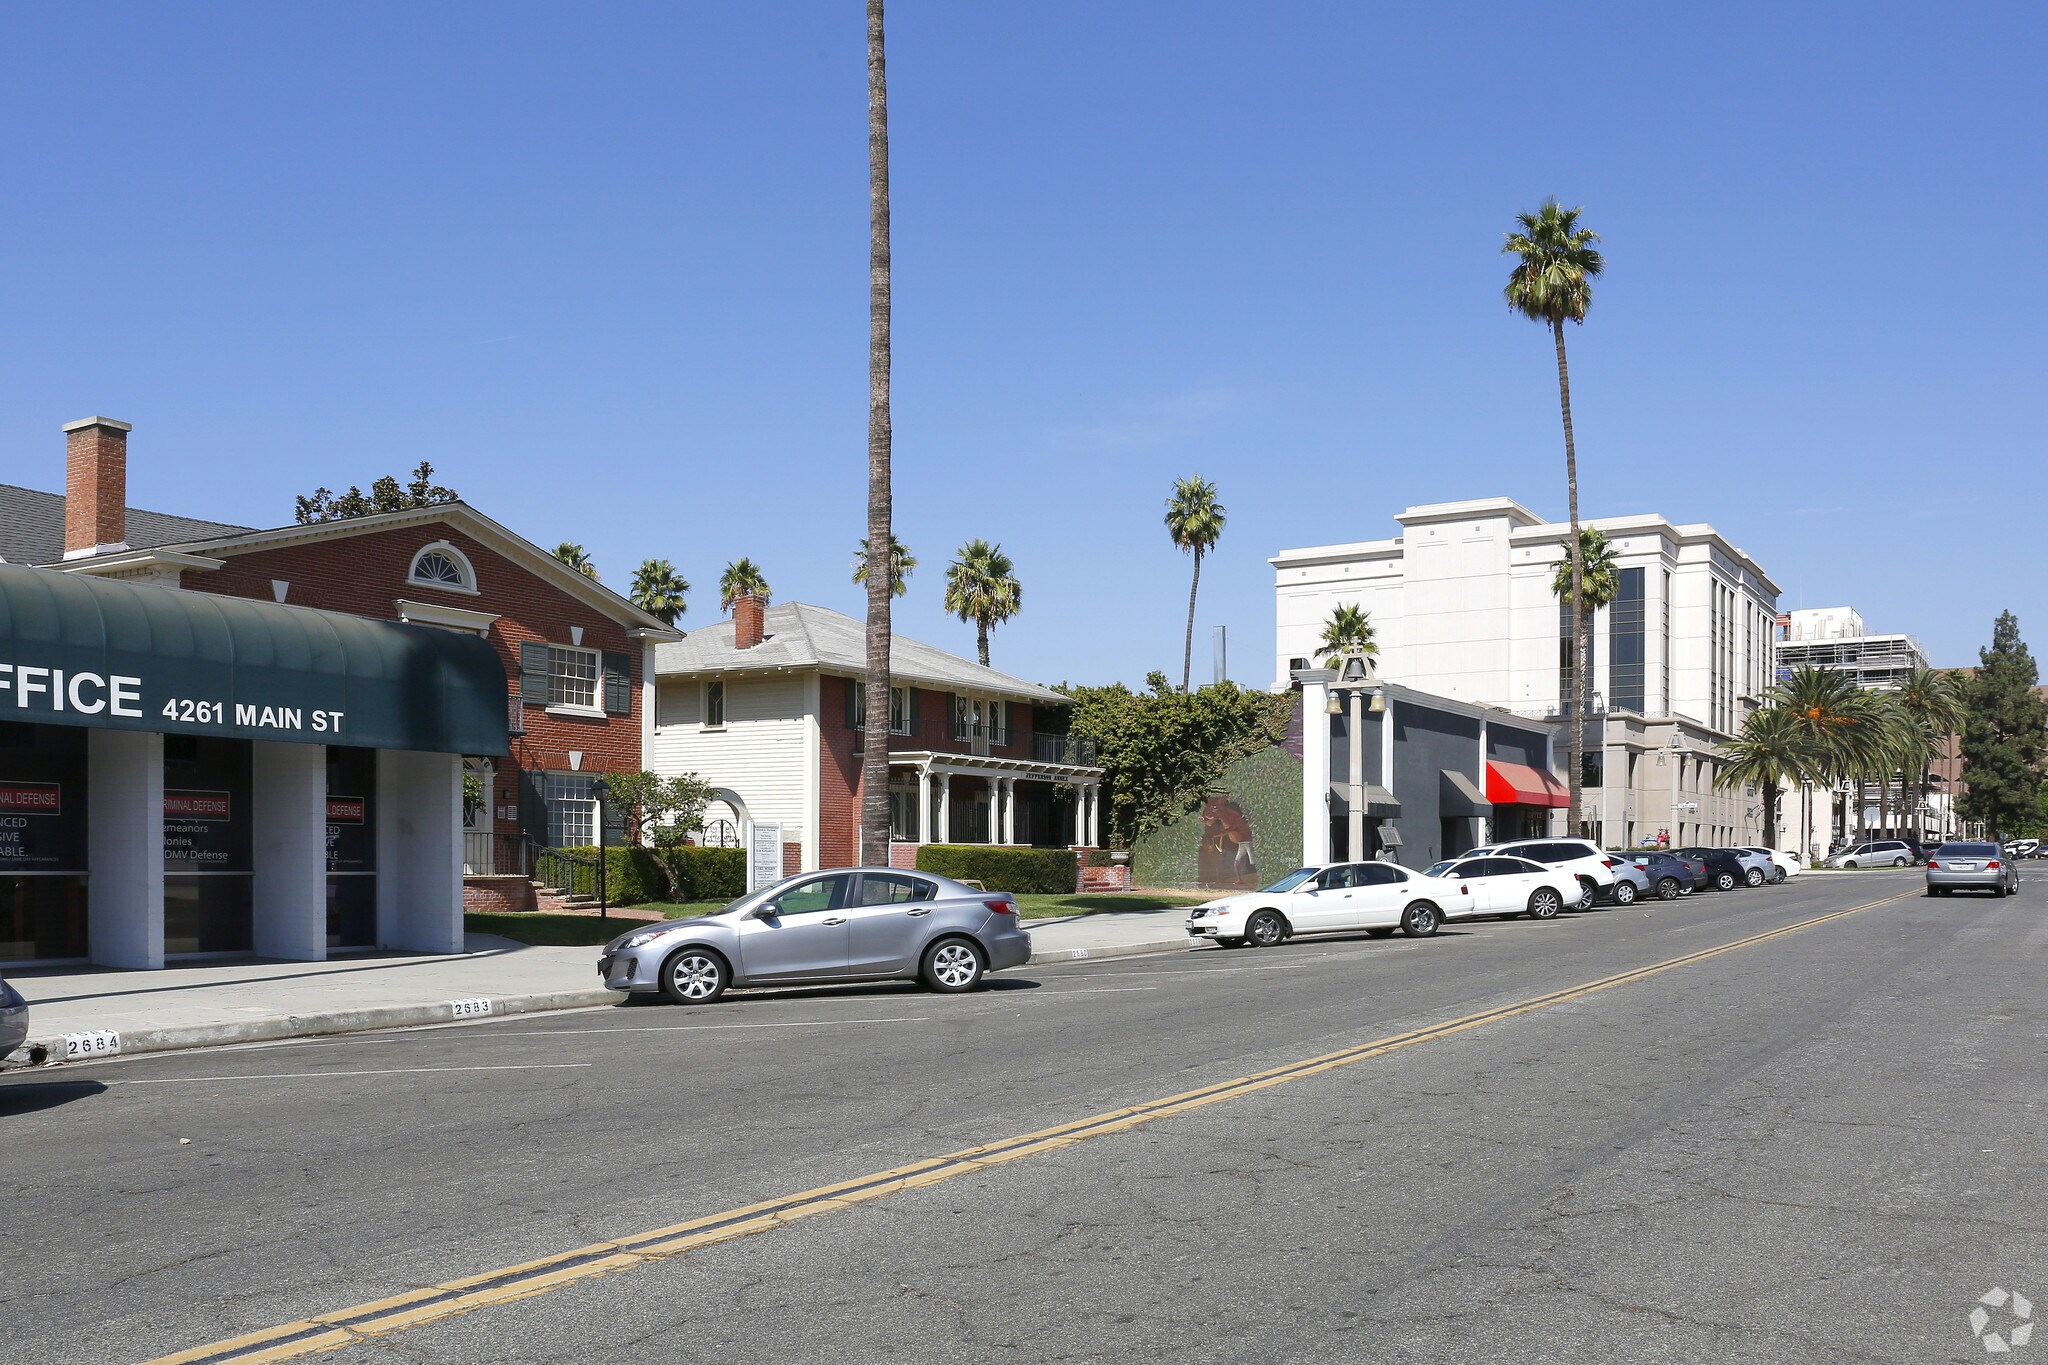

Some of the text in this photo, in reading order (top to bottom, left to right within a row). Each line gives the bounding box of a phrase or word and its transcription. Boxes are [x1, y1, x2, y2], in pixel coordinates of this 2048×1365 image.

[162, 698, 224, 724] 4261
[235, 703, 302, 730] MAIN
[311, 709, 344, 733] ST
[16, 792, 56, 805] DEFENSE
[193, 800, 227, 812] DEFENSE
[331, 805, 361, 817] DEFENSE
[164, 849, 229, 860] DMV Defense
[455, 1000, 489, 1015] 2683
[68, 1035, 120, 1055] 2684
